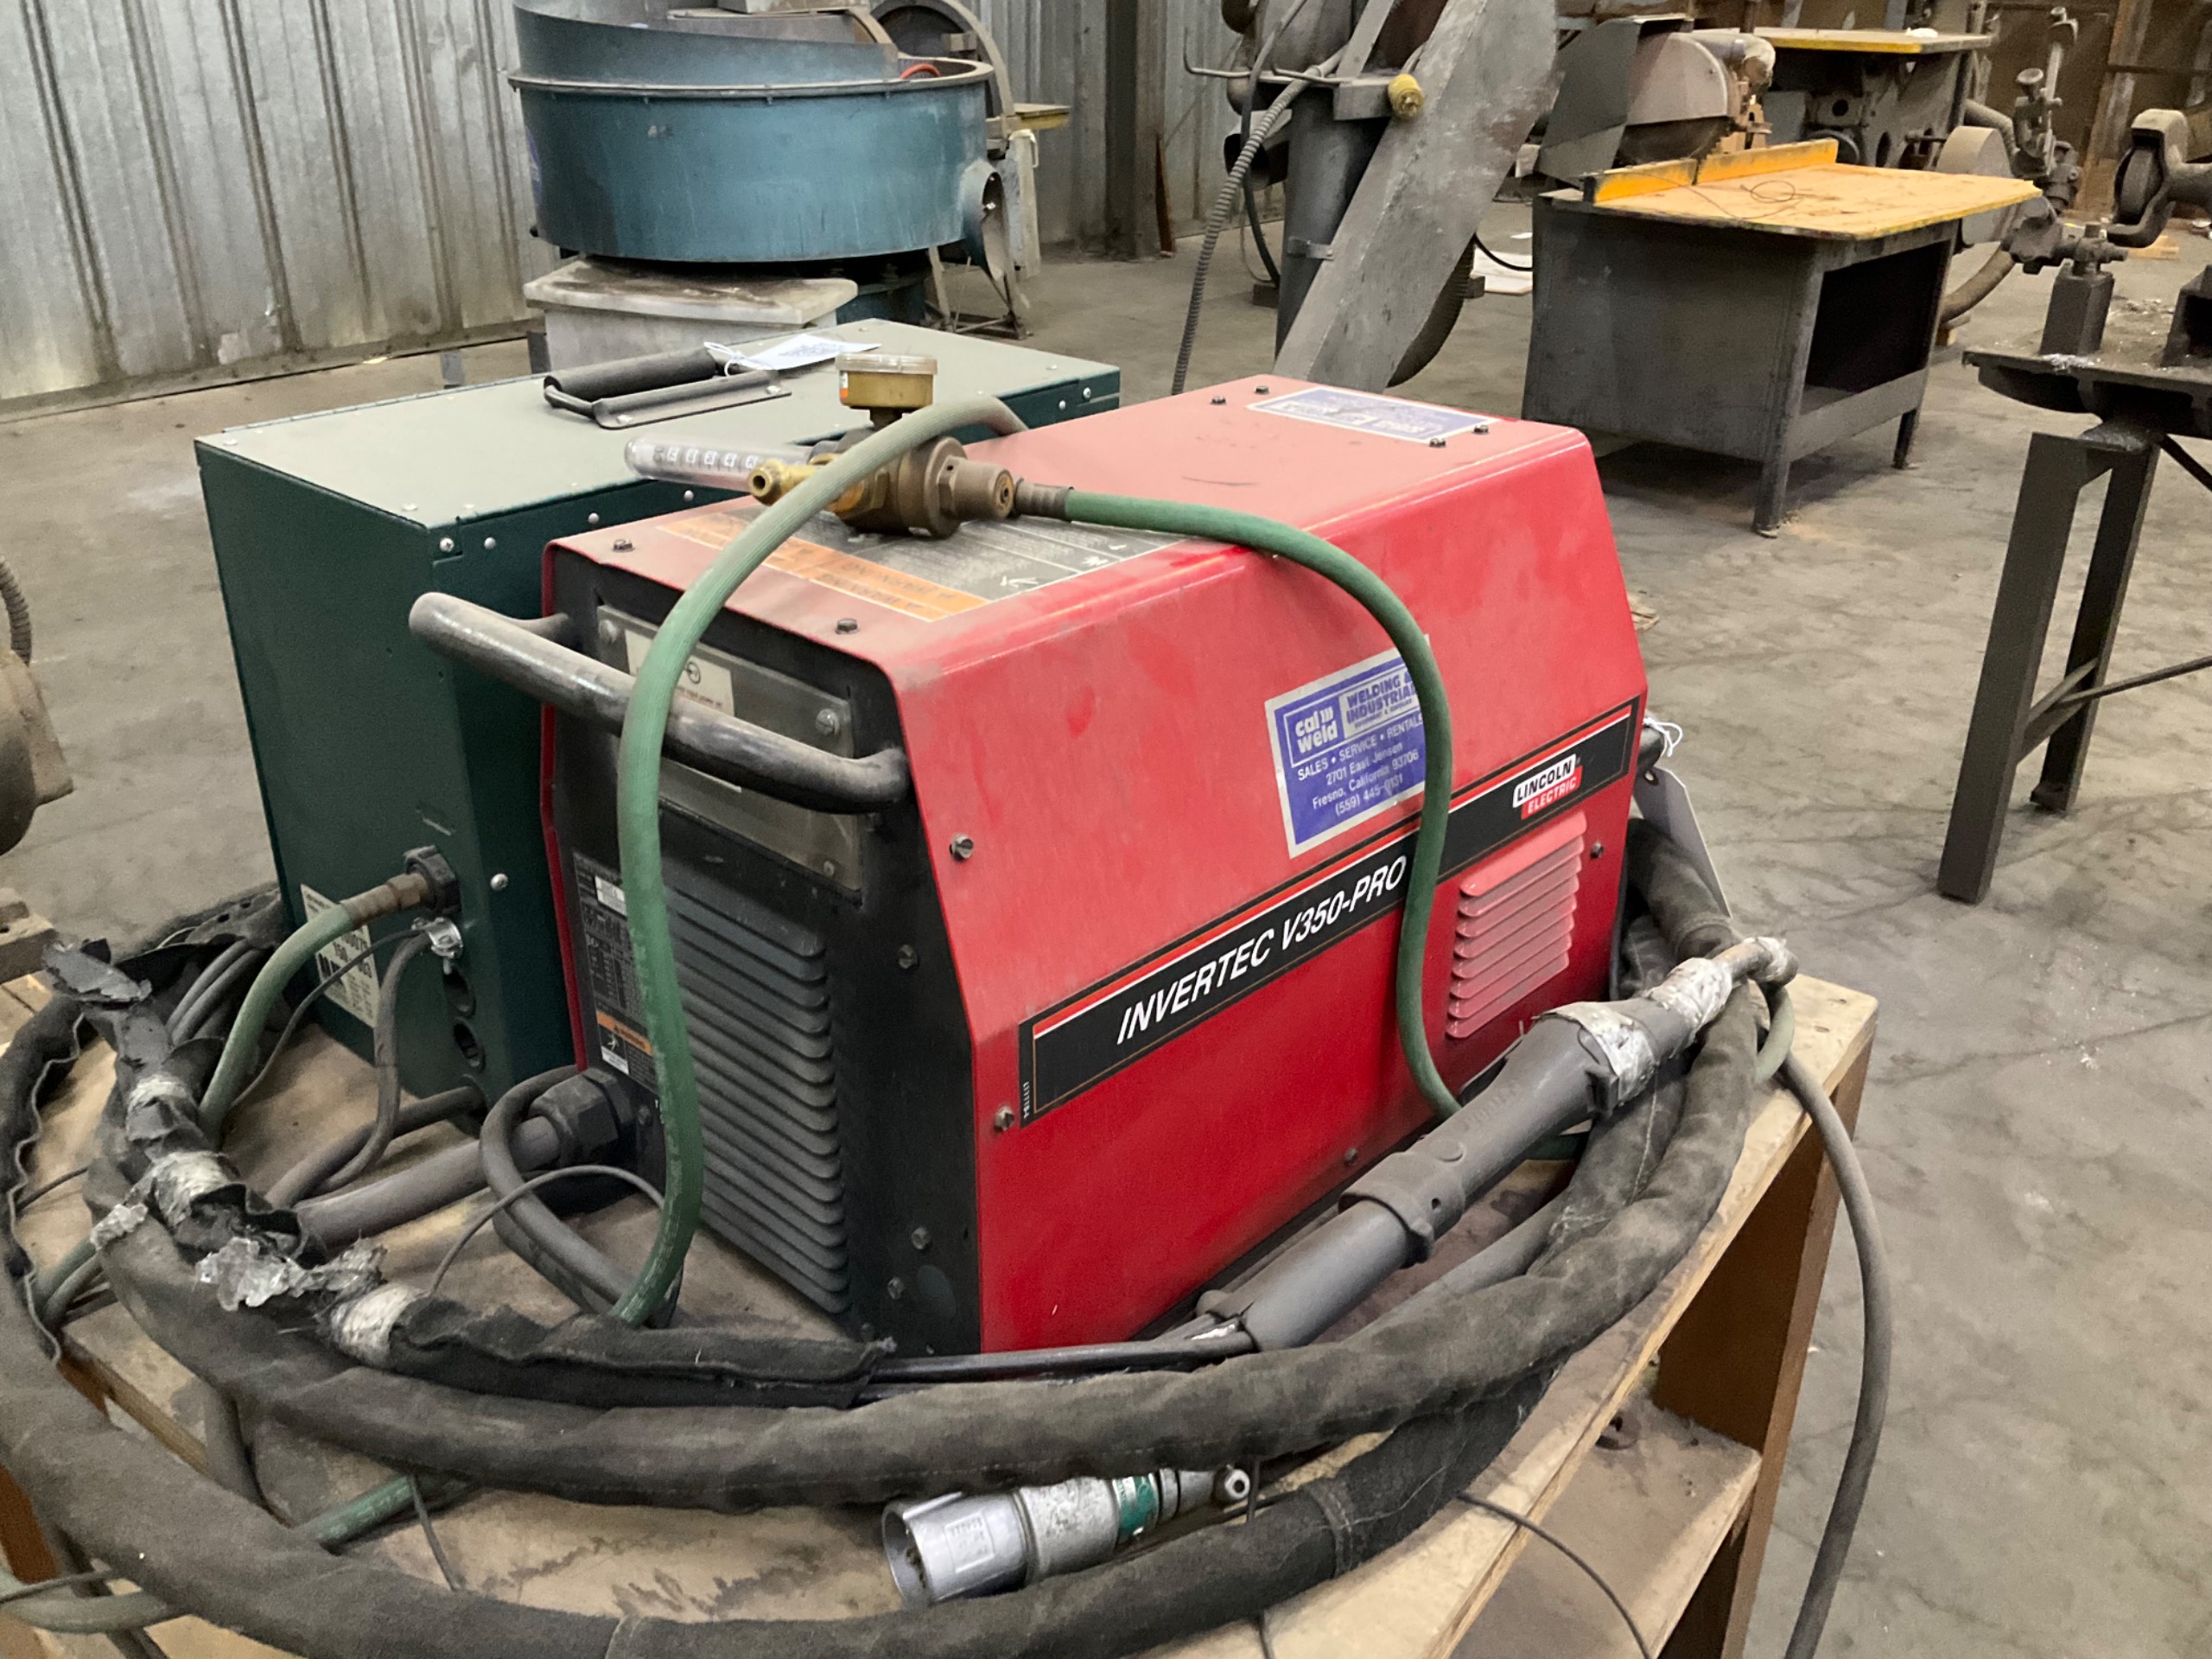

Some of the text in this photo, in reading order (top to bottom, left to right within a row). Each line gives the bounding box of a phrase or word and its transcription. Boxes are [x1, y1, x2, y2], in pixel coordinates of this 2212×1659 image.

[1346, 674, 1401, 709] WELDING
[1297, 720, 1338, 753] weld
[1297, 757, 1329, 781] SALES
[1338, 734, 1377, 762] SERVICE
[1325, 742, 1403, 786] 2701 East Jensen
[1349, 765, 1390, 791] California
[1392, 748, 1420, 770] 93706
[1517, 759, 1573, 802] LINCOLN
[1335, 792, 1361, 816] (559)
[1527, 776, 1578, 815] ELECTRIC
[1116, 855, 1408, 1046] INVERTEC V350-PRO
